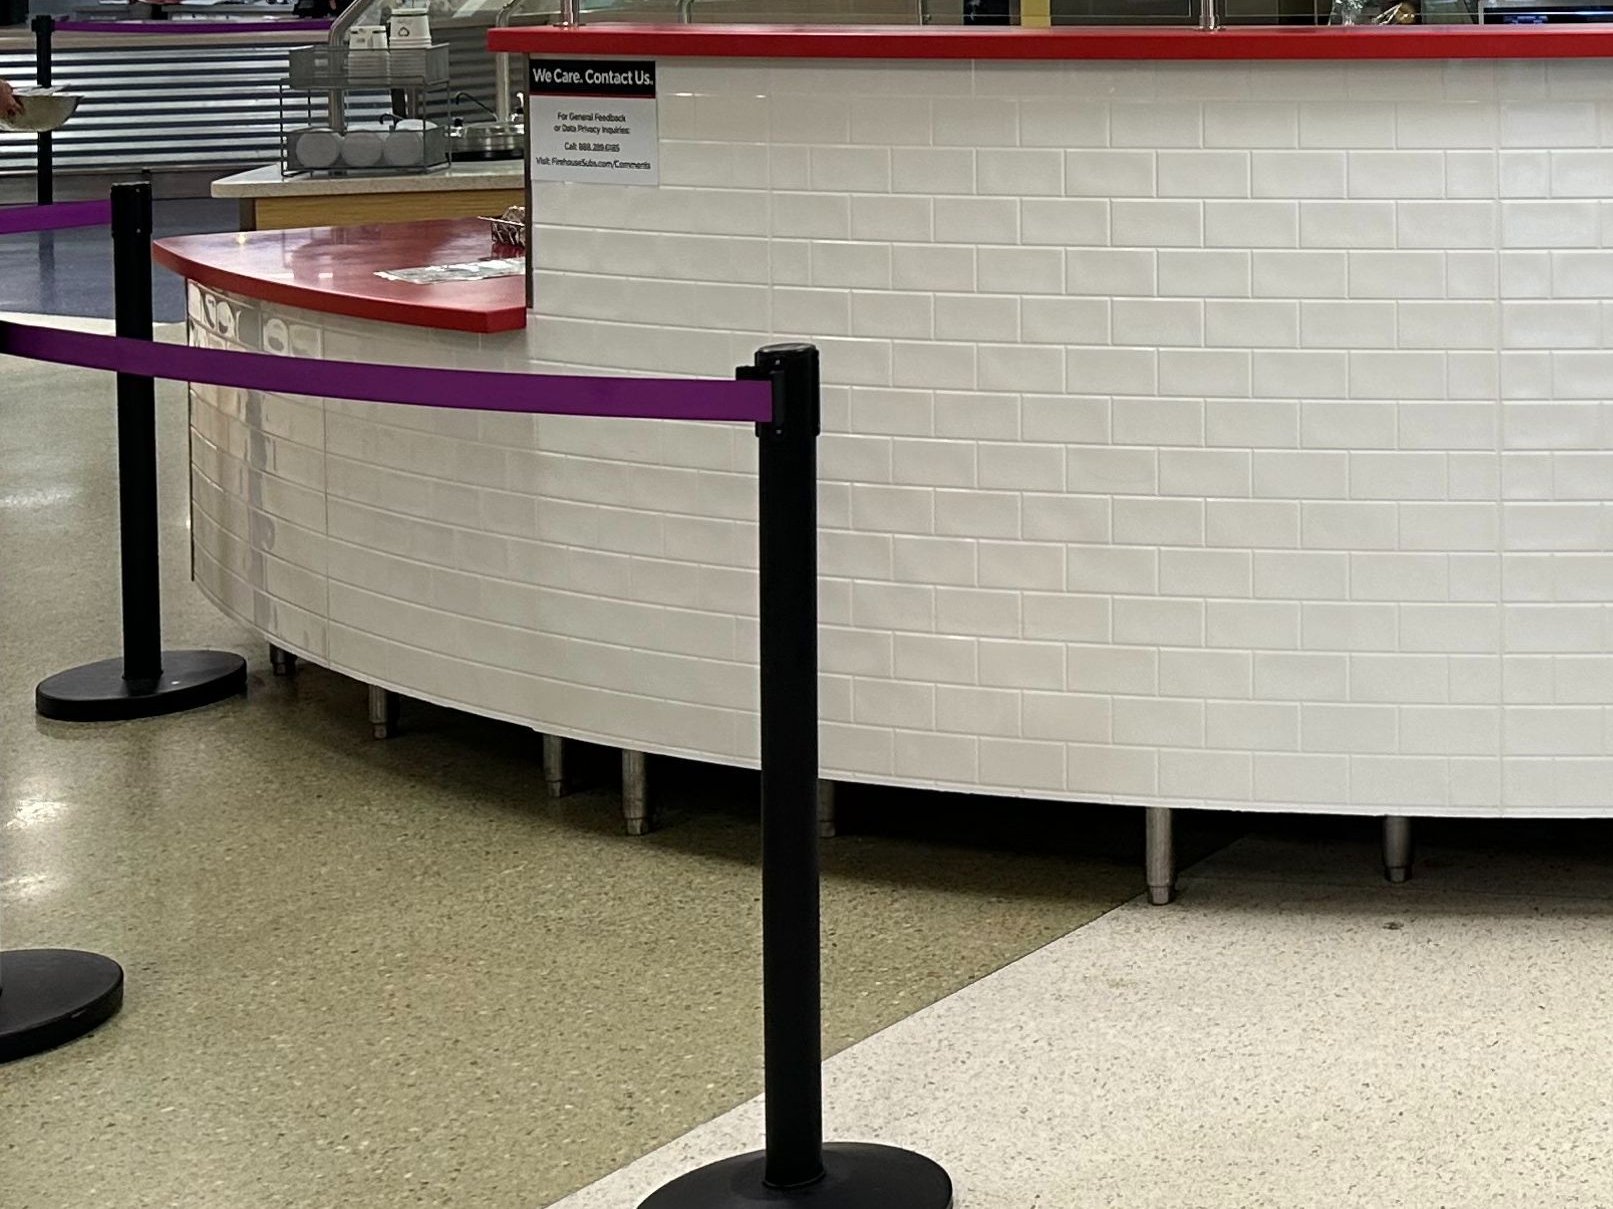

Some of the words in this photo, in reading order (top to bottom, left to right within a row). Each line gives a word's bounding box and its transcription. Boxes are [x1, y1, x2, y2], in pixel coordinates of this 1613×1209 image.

[532, 68, 553, 83] We
[553, 68, 584, 83] Care.
[585, 69, 633, 85] Contact
[557, 111, 568, 121] For
[568, 112, 594, 122] General
[594, 113, 626, 123] Feedback
[561, 124, 577, 133] Data
[577, 124, 601, 135] Privacy
